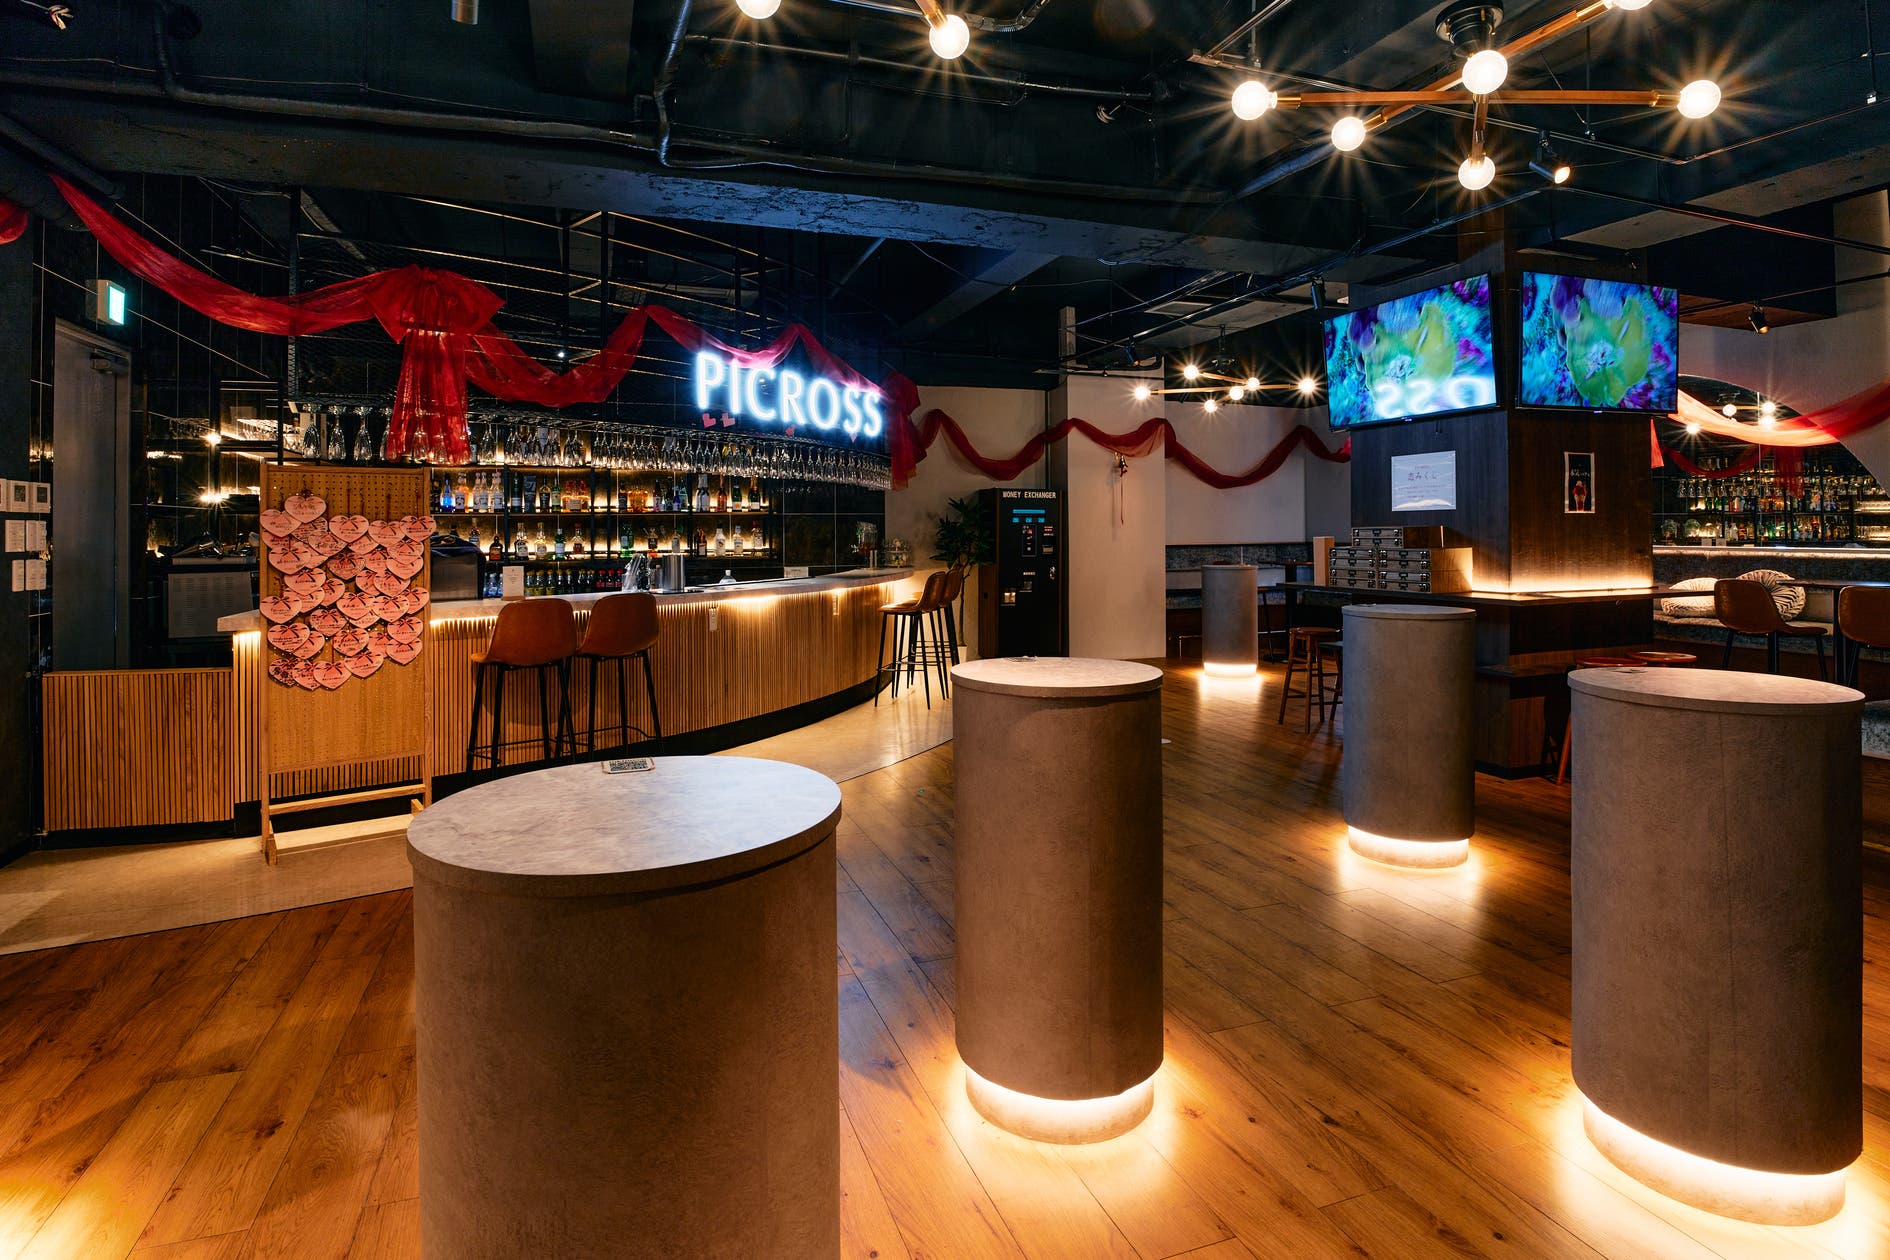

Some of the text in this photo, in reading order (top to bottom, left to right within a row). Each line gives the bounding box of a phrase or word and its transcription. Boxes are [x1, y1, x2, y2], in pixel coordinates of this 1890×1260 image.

[696, 351, 883, 438] PICROSS
[1002, 490, 1057, 499] MONEY EXCHANGER
